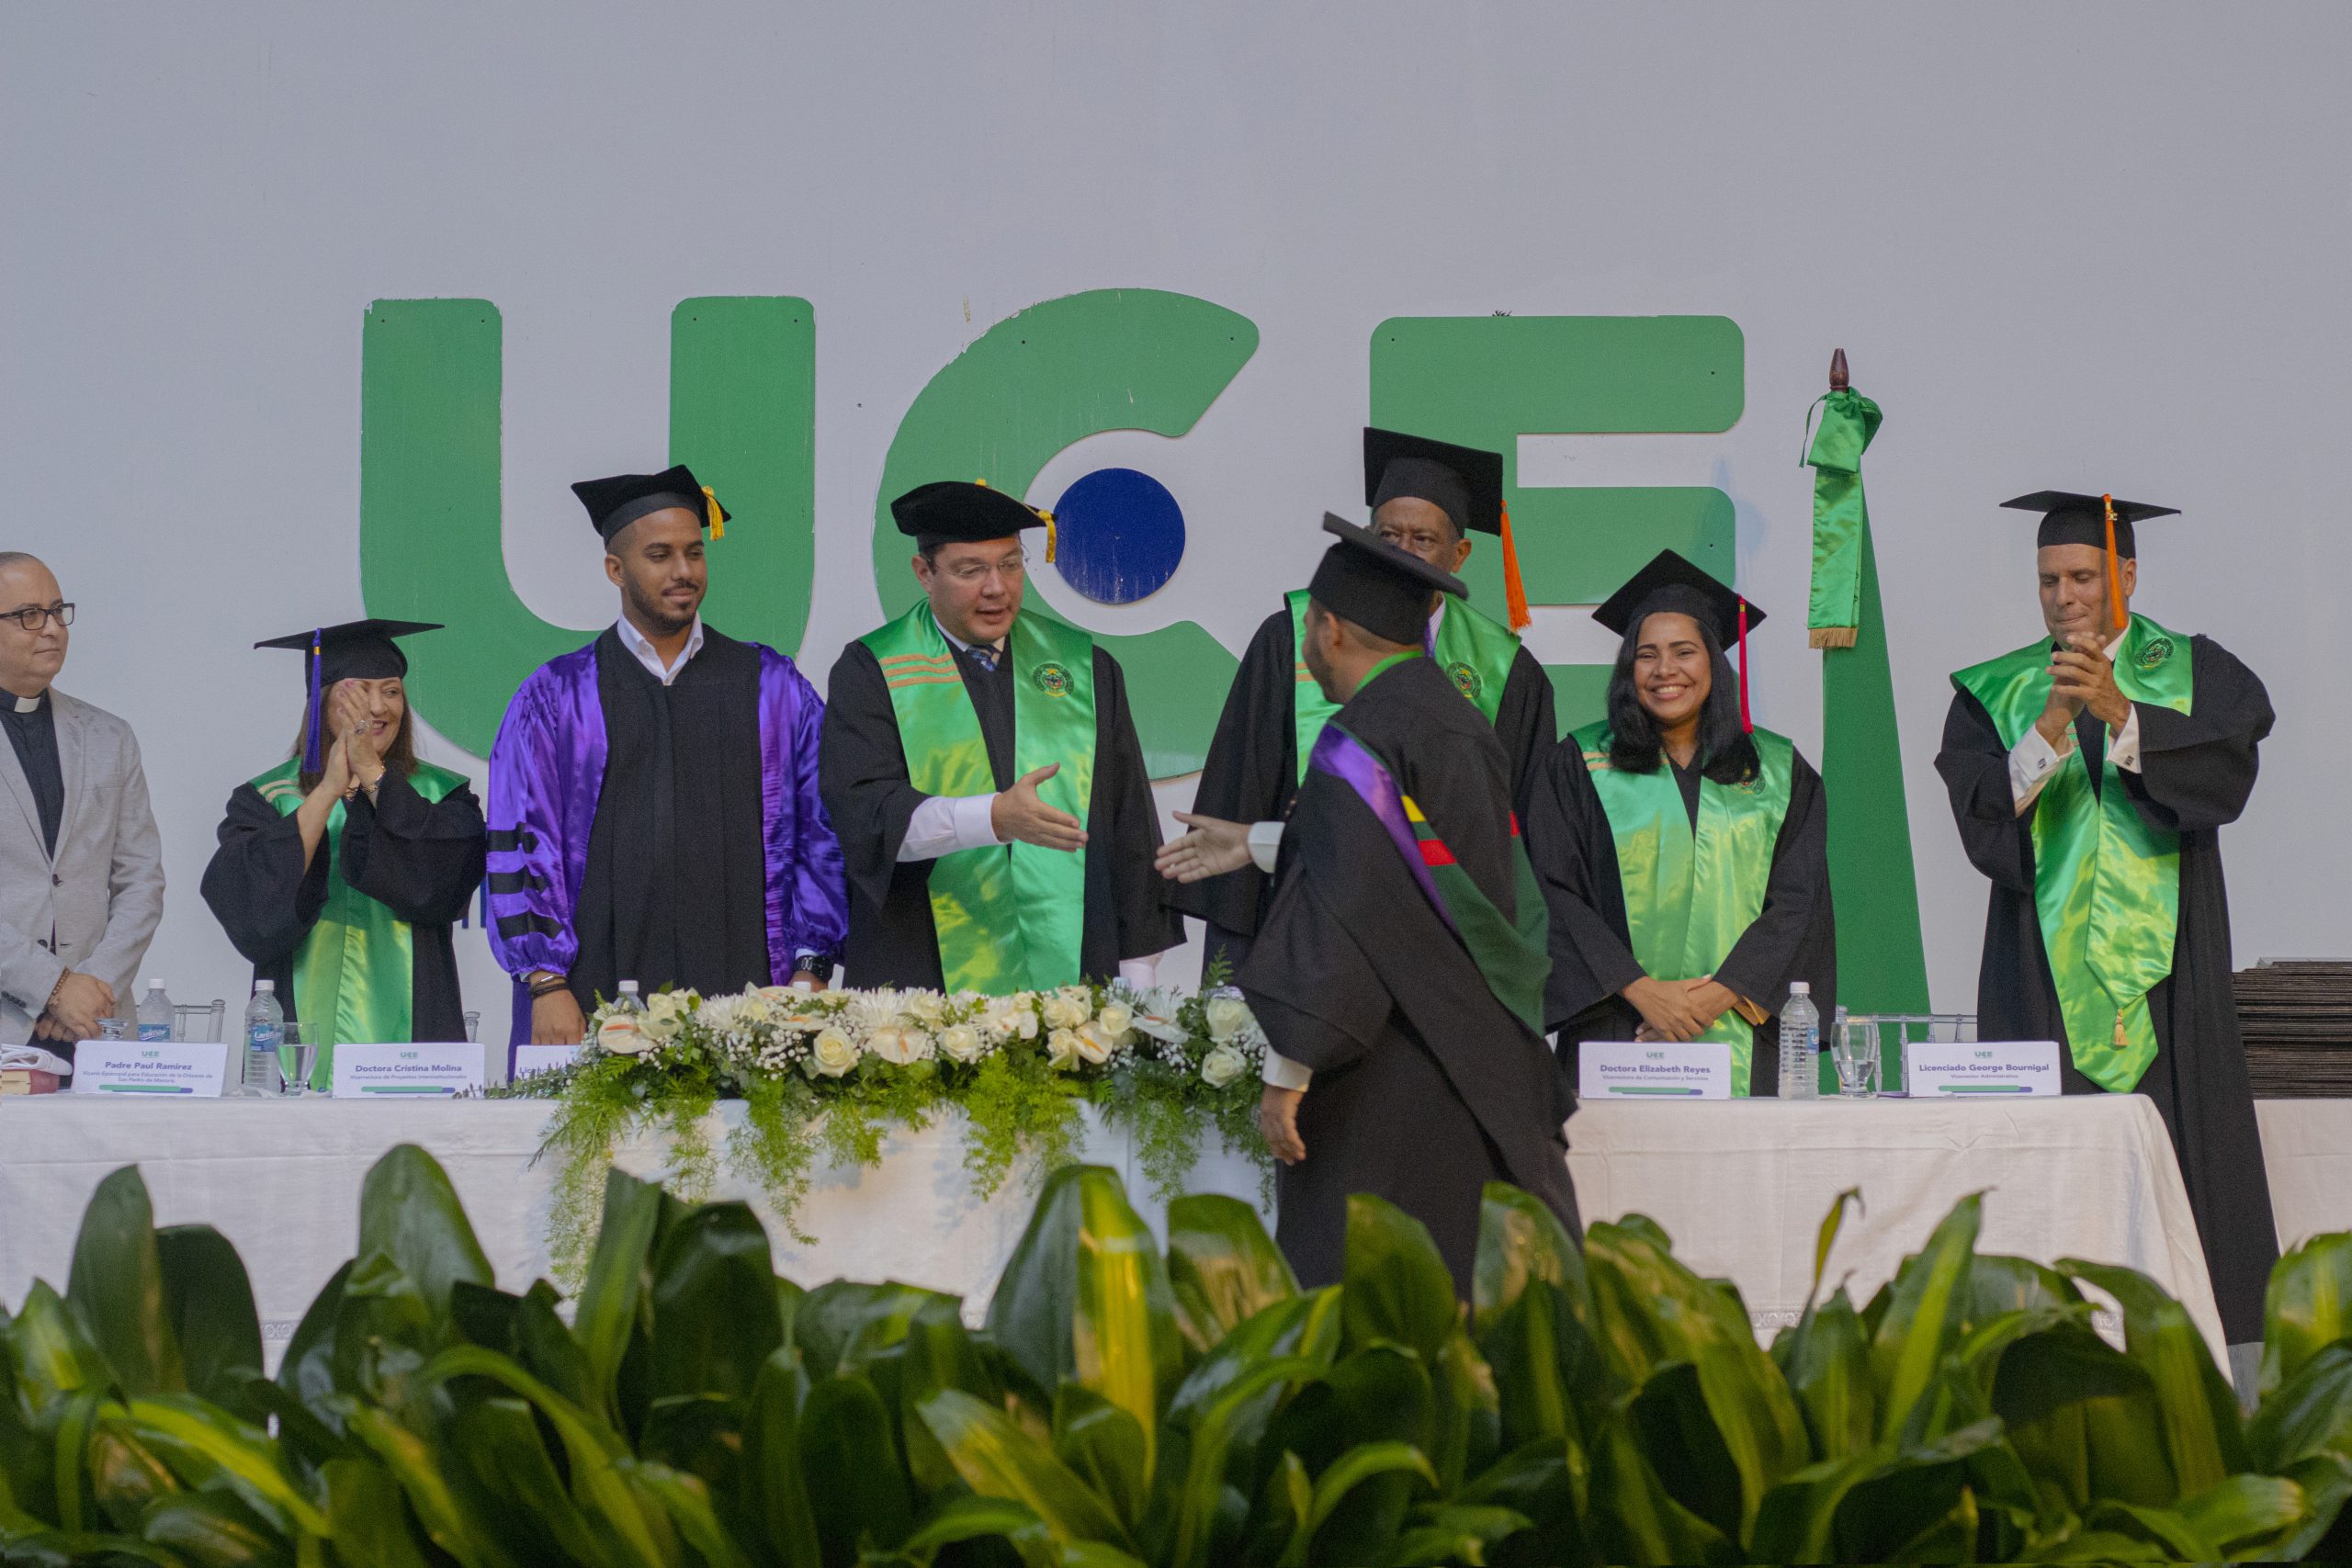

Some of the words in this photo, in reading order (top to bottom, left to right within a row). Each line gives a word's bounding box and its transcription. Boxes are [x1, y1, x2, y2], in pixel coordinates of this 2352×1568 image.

[360, 288, 1745, 779] UCE
[105, 1061, 131, 1069] Padre
[1639, 1065, 1681, 1073] Elizabeth
[1683, 1066, 1711, 1074] Reyes
[1919, 1064, 1966, 1072] Licenciado
[1969, 1064, 2003, 1073] George
[2006, 1064, 2050, 1073] Bournigal
